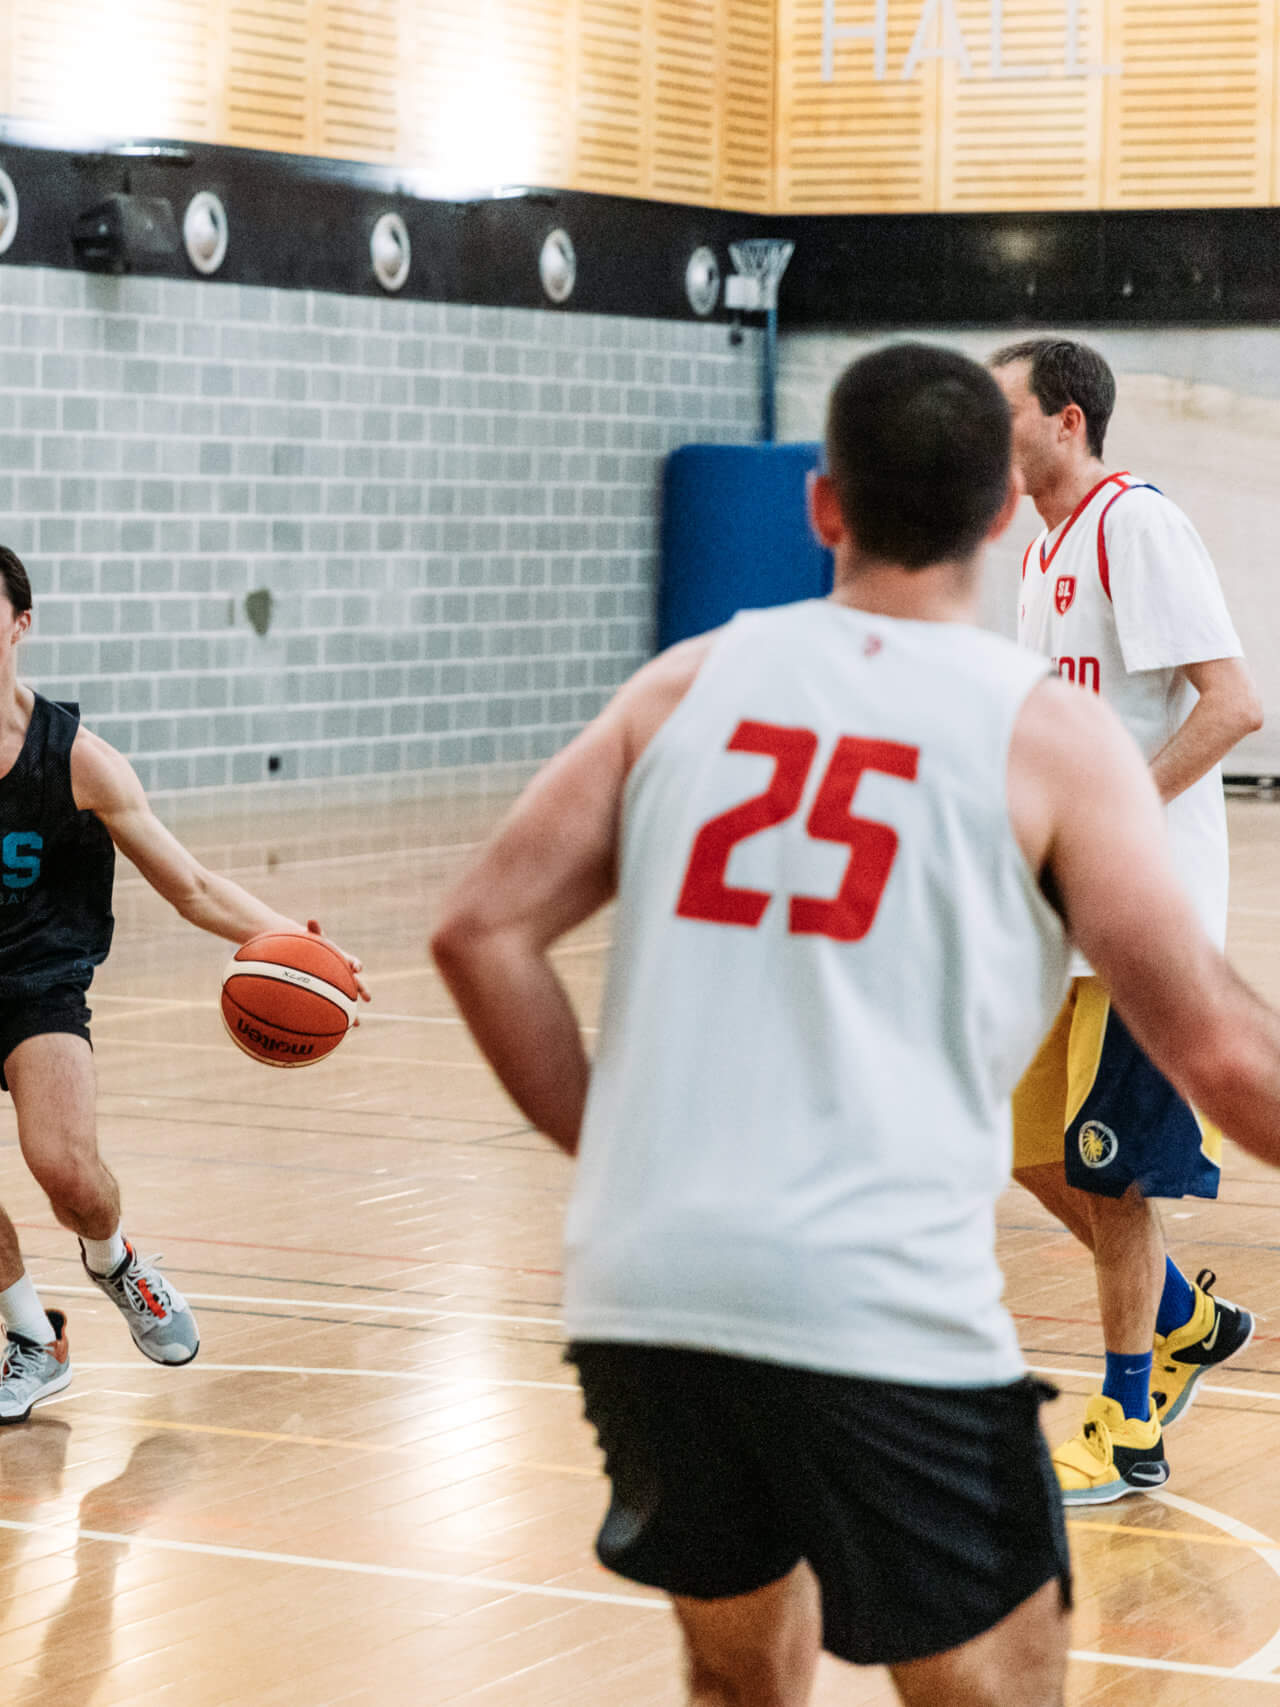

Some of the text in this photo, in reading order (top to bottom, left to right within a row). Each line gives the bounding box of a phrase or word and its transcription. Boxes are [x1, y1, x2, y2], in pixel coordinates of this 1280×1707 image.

[821, 0, 1122, 82] HALL
[675, 719, 921, 942] 25
[236, 1018, 315, 1056] molten
